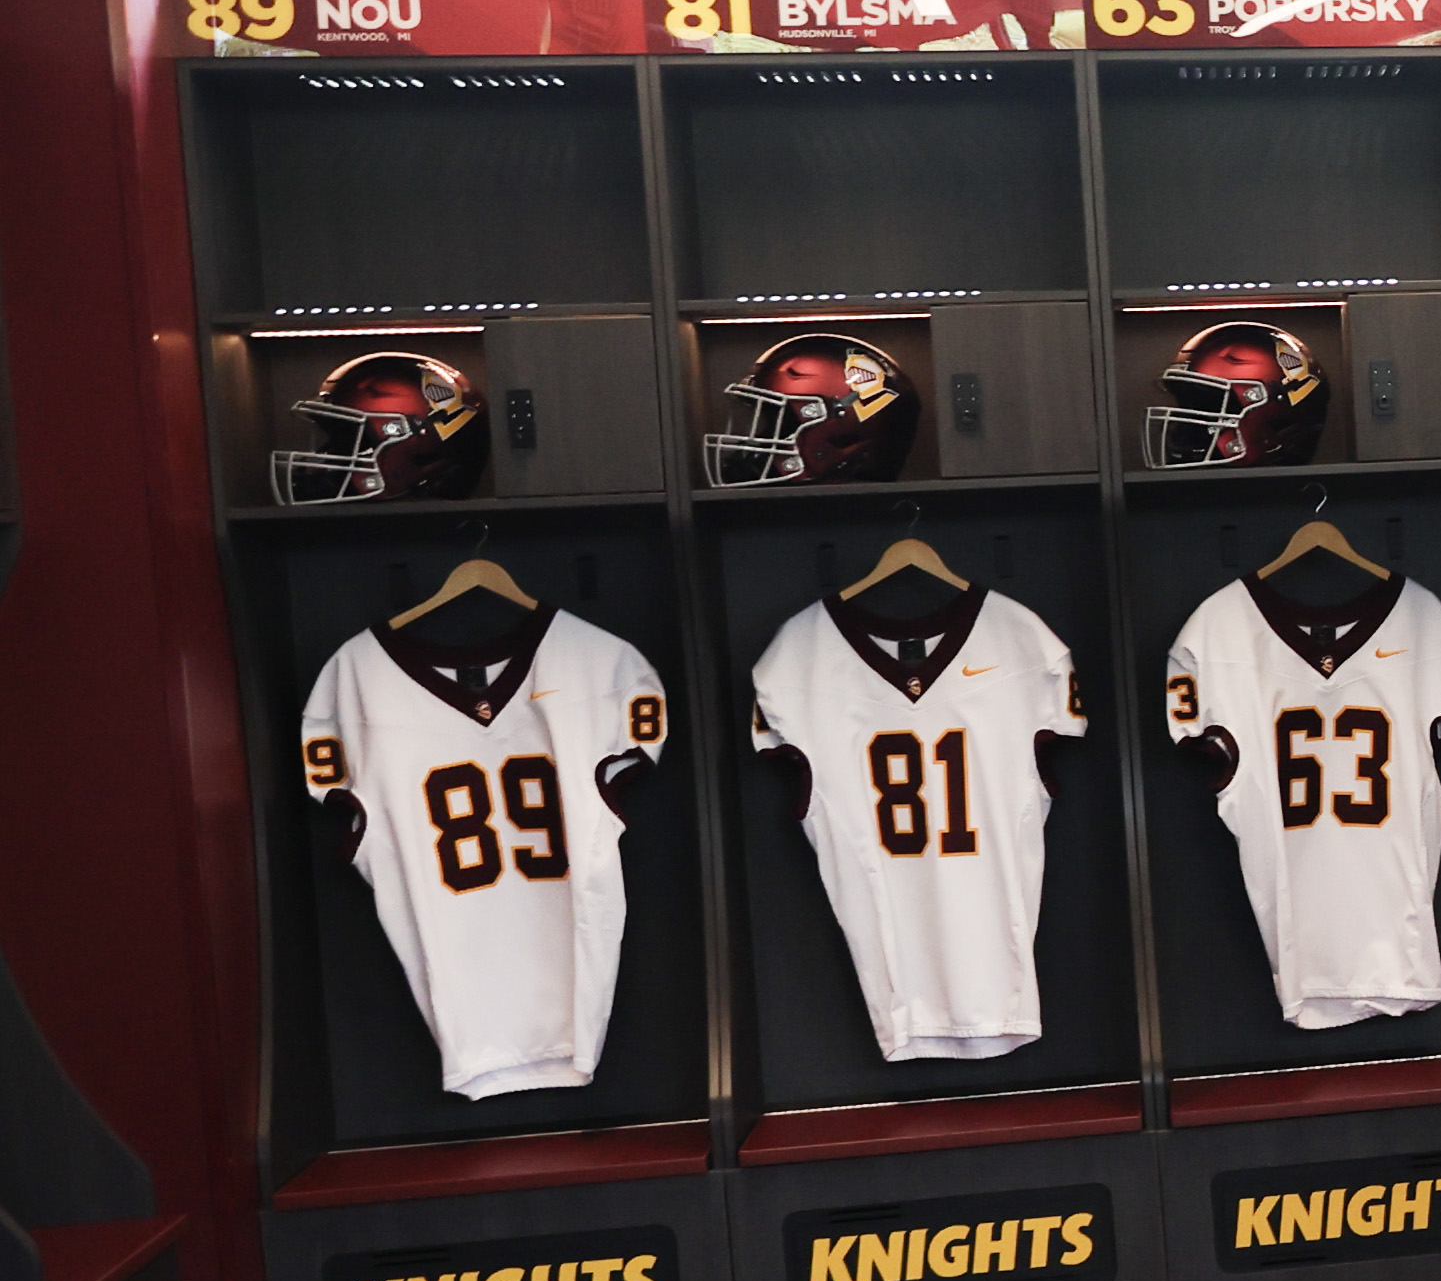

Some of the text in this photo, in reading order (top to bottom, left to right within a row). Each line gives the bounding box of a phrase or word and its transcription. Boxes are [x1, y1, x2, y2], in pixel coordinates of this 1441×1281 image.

[317, 33, 411, 42] KENTWOOD, MI
[778, 29, 876, 38] HUDSONVILLE, MI
[628, 694, 663, 743] 8
[1167, 674, 1199, 723] 3
[302, 736, 349, 787] 9
[1274, 704, 1393, 831] 63
[867, 727, 980, 859] 81
[422, 751, 570, 896] 89
